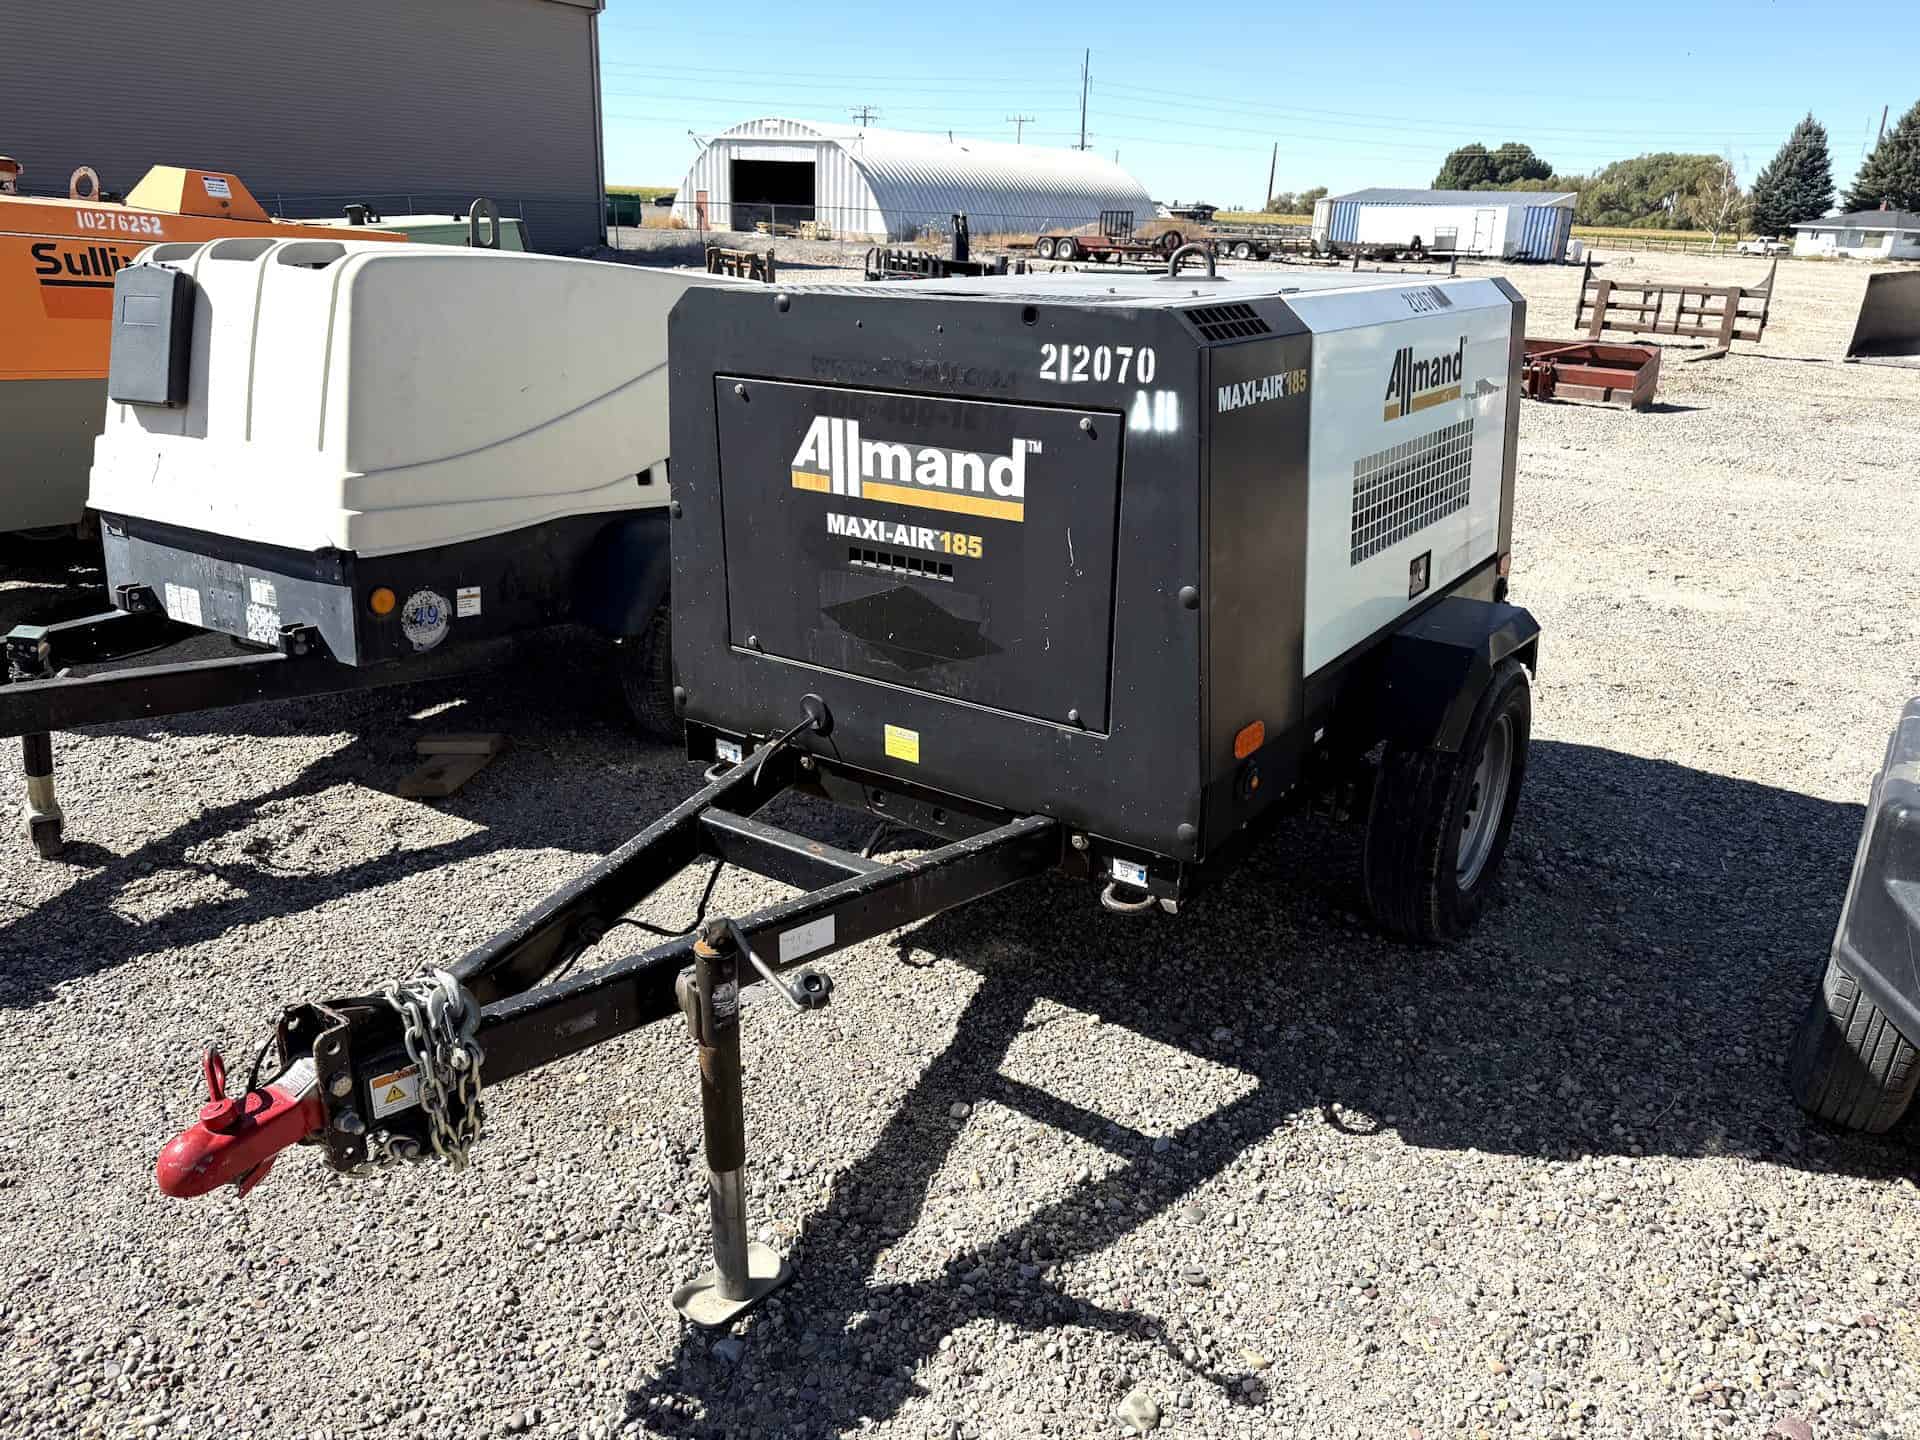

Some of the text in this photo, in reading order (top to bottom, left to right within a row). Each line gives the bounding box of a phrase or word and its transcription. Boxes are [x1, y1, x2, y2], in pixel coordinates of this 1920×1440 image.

[76, 211, 164, 235] 10276252
[31, 243, 133, 276] Sulli
[1039, 343, 1156, 384] 212070
[1385, 336, 1464, 416] Allmand
[1218, 368, 1307, 413] MAXI-AIR 185
[791, 415, 1026, 498] Allmand
[826, 512, 984, 559] MAXI-AIR 185
